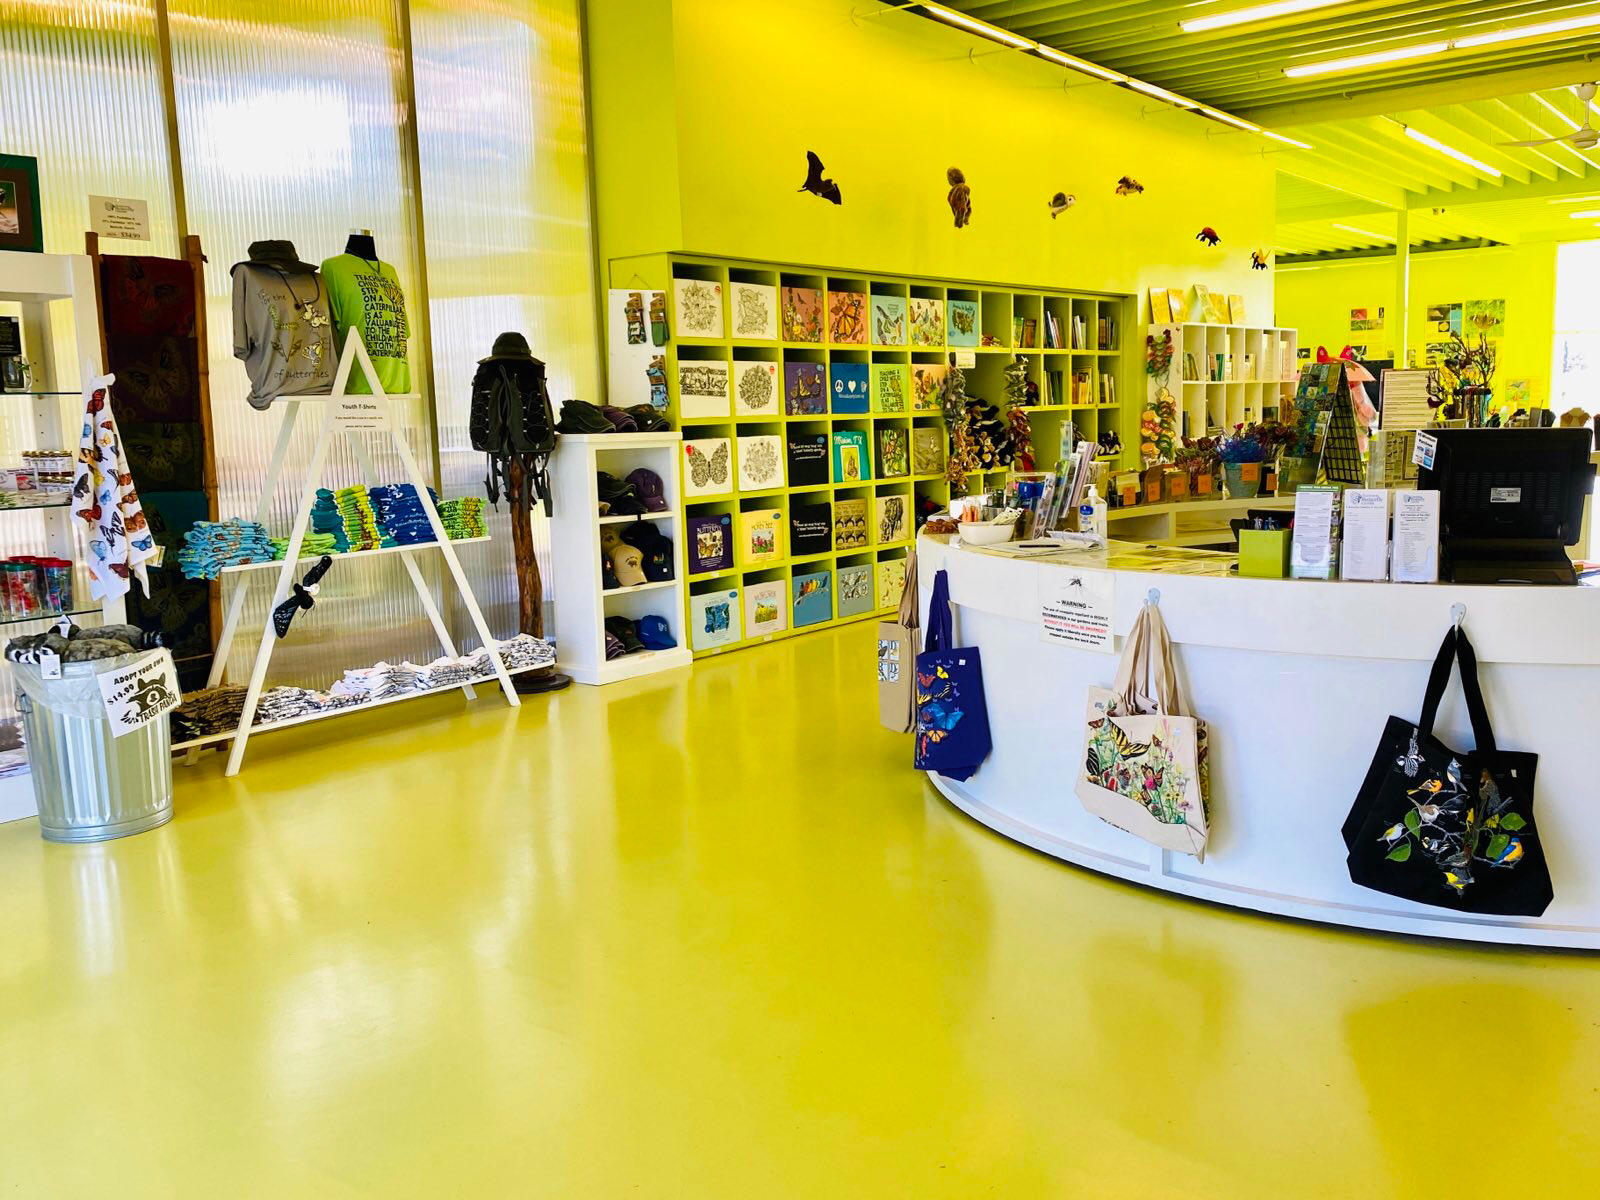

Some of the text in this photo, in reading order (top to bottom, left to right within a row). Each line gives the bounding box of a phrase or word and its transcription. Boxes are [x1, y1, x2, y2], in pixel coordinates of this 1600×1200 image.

[354, 274, 388, 284] TEACHING
[1061, 600, 1086, 608] WARNING
[114, 656, 164, 685] ADOPT YOUR OWN
[107, 684, 134, 705] $14.99
[140, 693, 177, 722] TRASH PANDA
